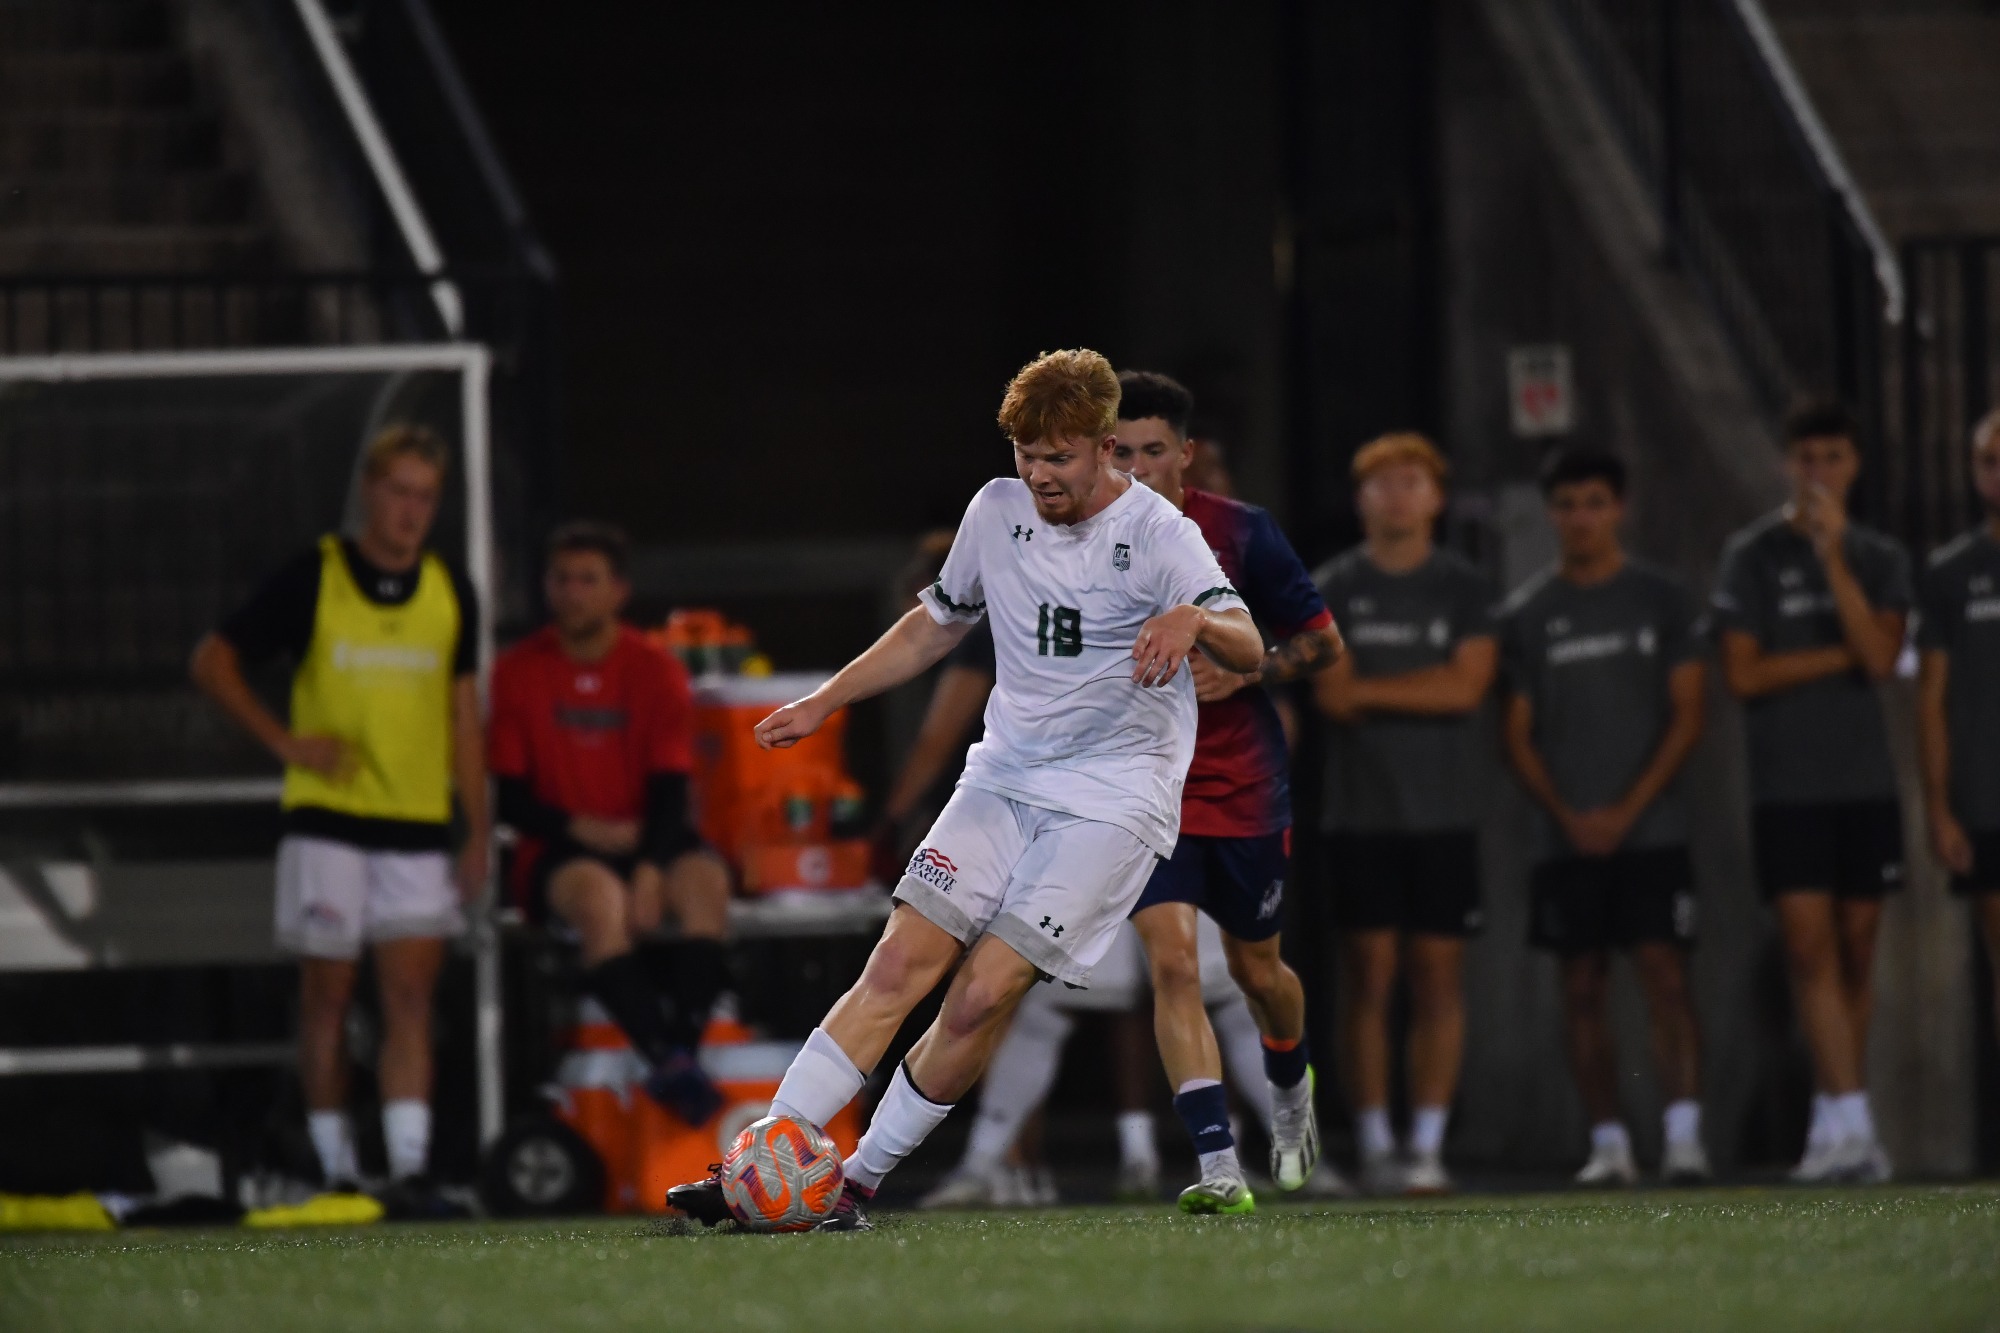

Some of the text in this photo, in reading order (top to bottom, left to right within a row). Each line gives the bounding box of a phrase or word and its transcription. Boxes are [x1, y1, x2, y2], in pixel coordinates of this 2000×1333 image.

[1038, 602, 1083, 657] 18
[907, 867, 952, 895] EAGUE
[909, 861, 957, 887] ATRIOT
